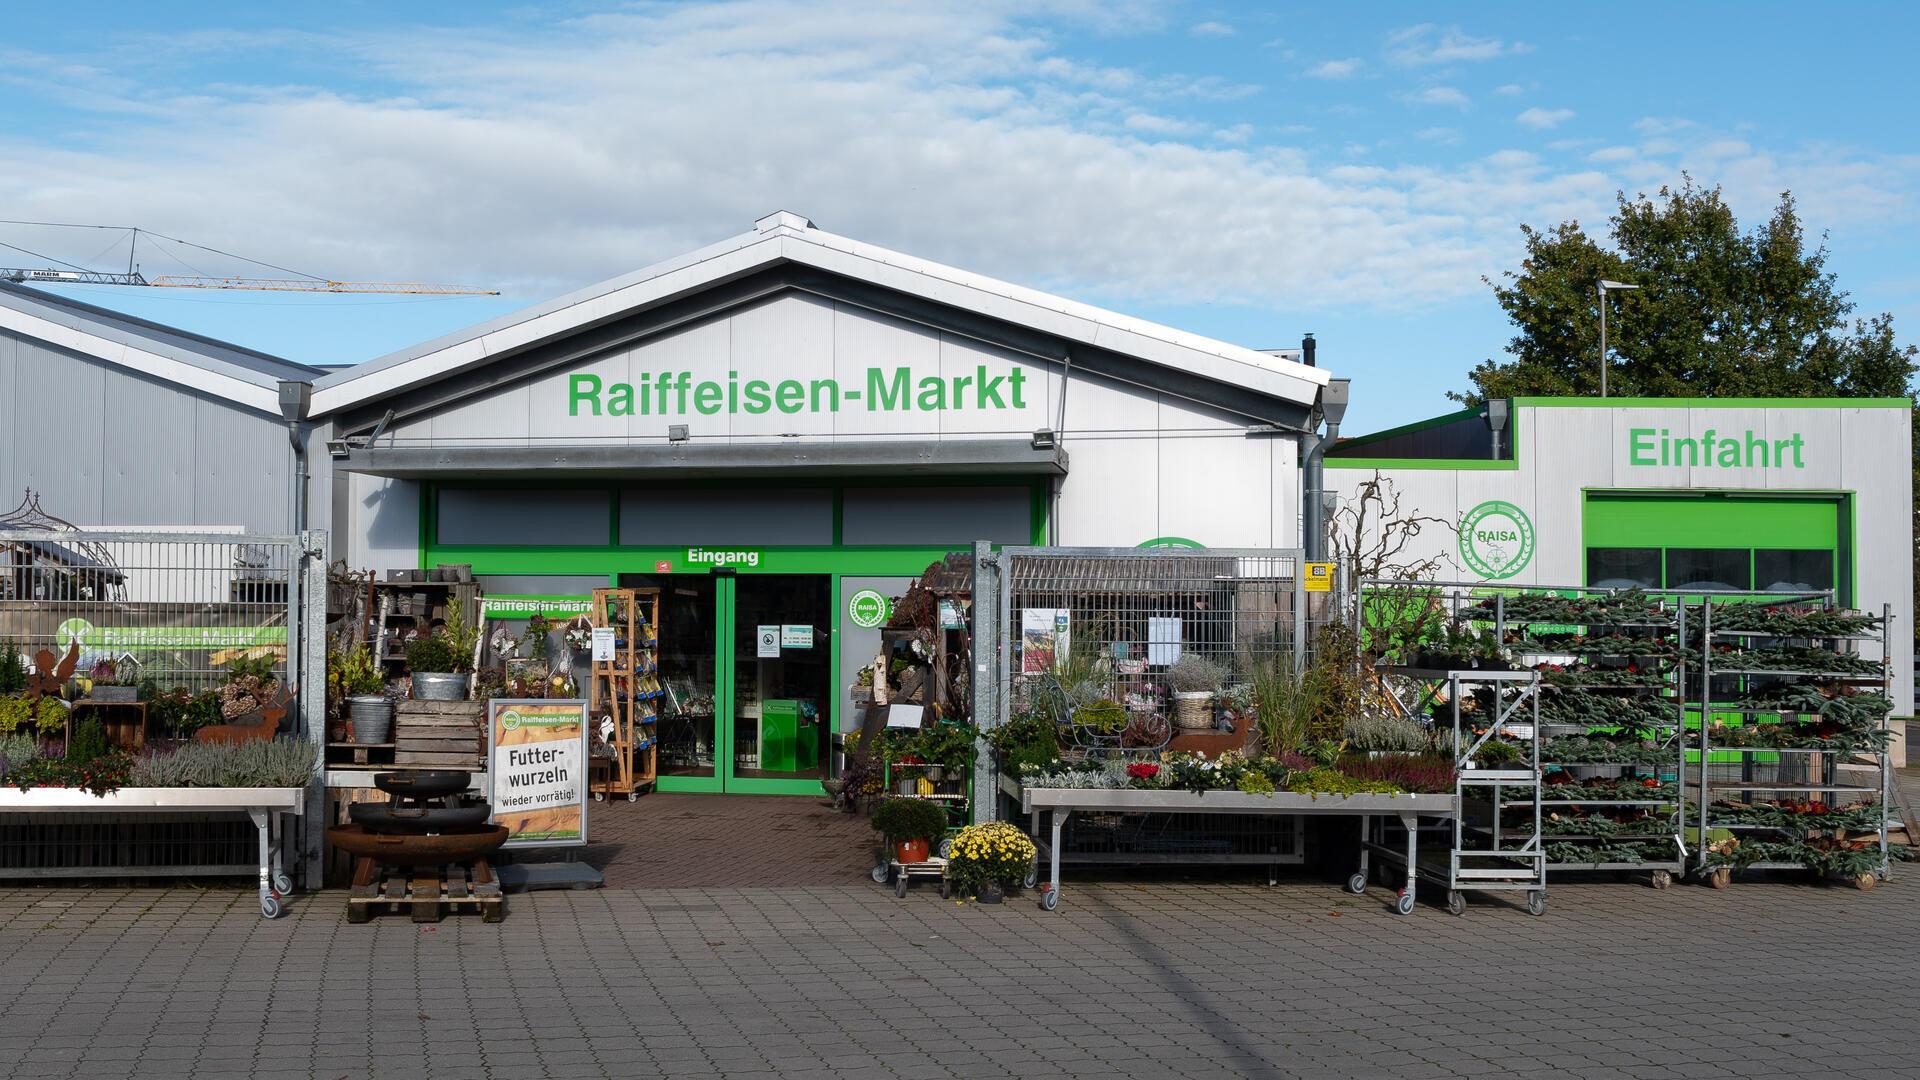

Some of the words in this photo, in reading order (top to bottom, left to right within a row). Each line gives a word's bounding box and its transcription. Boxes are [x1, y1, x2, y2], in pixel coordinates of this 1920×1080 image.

[568, 365, 1026, 417] Raiffeisen-Markt
[1630, 428, 1805, 469] Einfahrt
[1478, 531, 1518, 541] RAISA
[687, 548, 759, 566] Eingang
[509, 747, 564, 766] Futter-
[509, 766, 568, 787] wurzeln
[502, 795, 533, 807] wieder
[536, 789, 574, 801] vorrätig!
